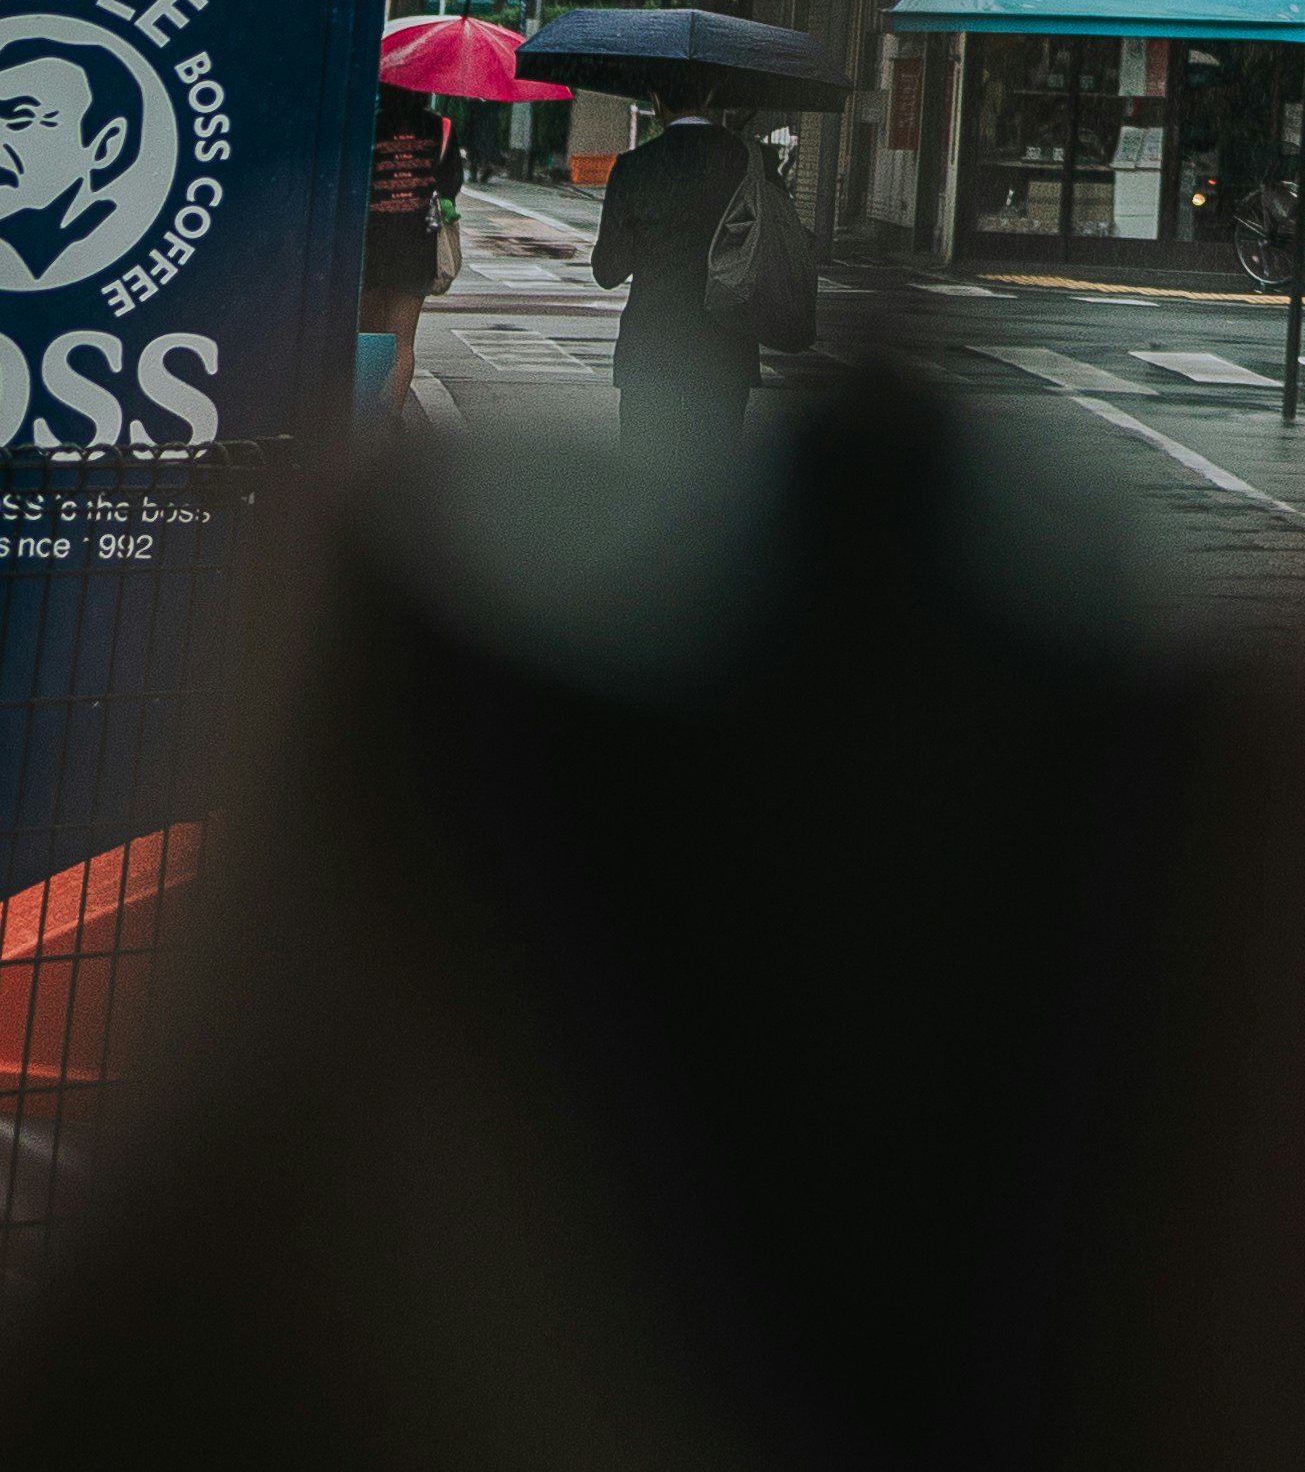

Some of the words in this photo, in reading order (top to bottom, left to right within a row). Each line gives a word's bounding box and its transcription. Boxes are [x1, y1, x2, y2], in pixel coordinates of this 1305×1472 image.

[173, 50, 232, 162] BOSS
[100, 176, 224, 318] COFFEE
[0, 536, 71, 559] snce
[83, 533, 153, 559] 992
